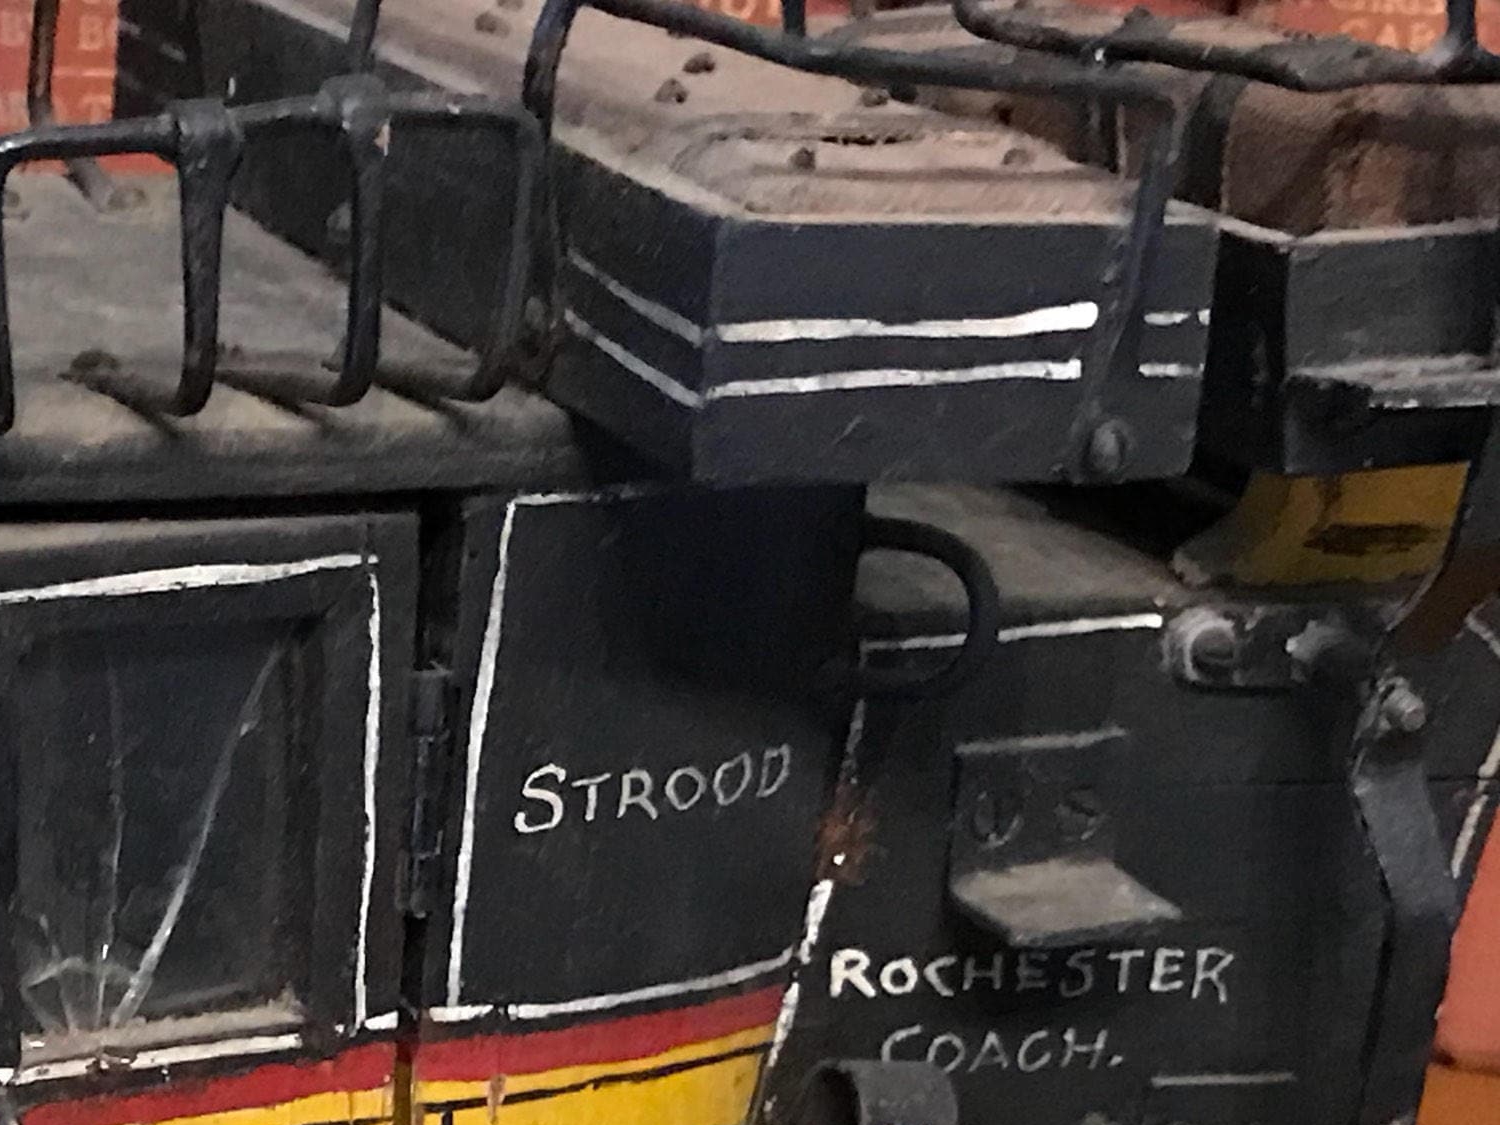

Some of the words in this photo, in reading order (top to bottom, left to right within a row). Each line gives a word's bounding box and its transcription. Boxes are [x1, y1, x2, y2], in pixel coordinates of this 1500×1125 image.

[513, 743, 791, 834] STROOD
[829, 947, 1236, 1003] ROCHESTER
[881, 1024, 1124, 1074] COACH.
